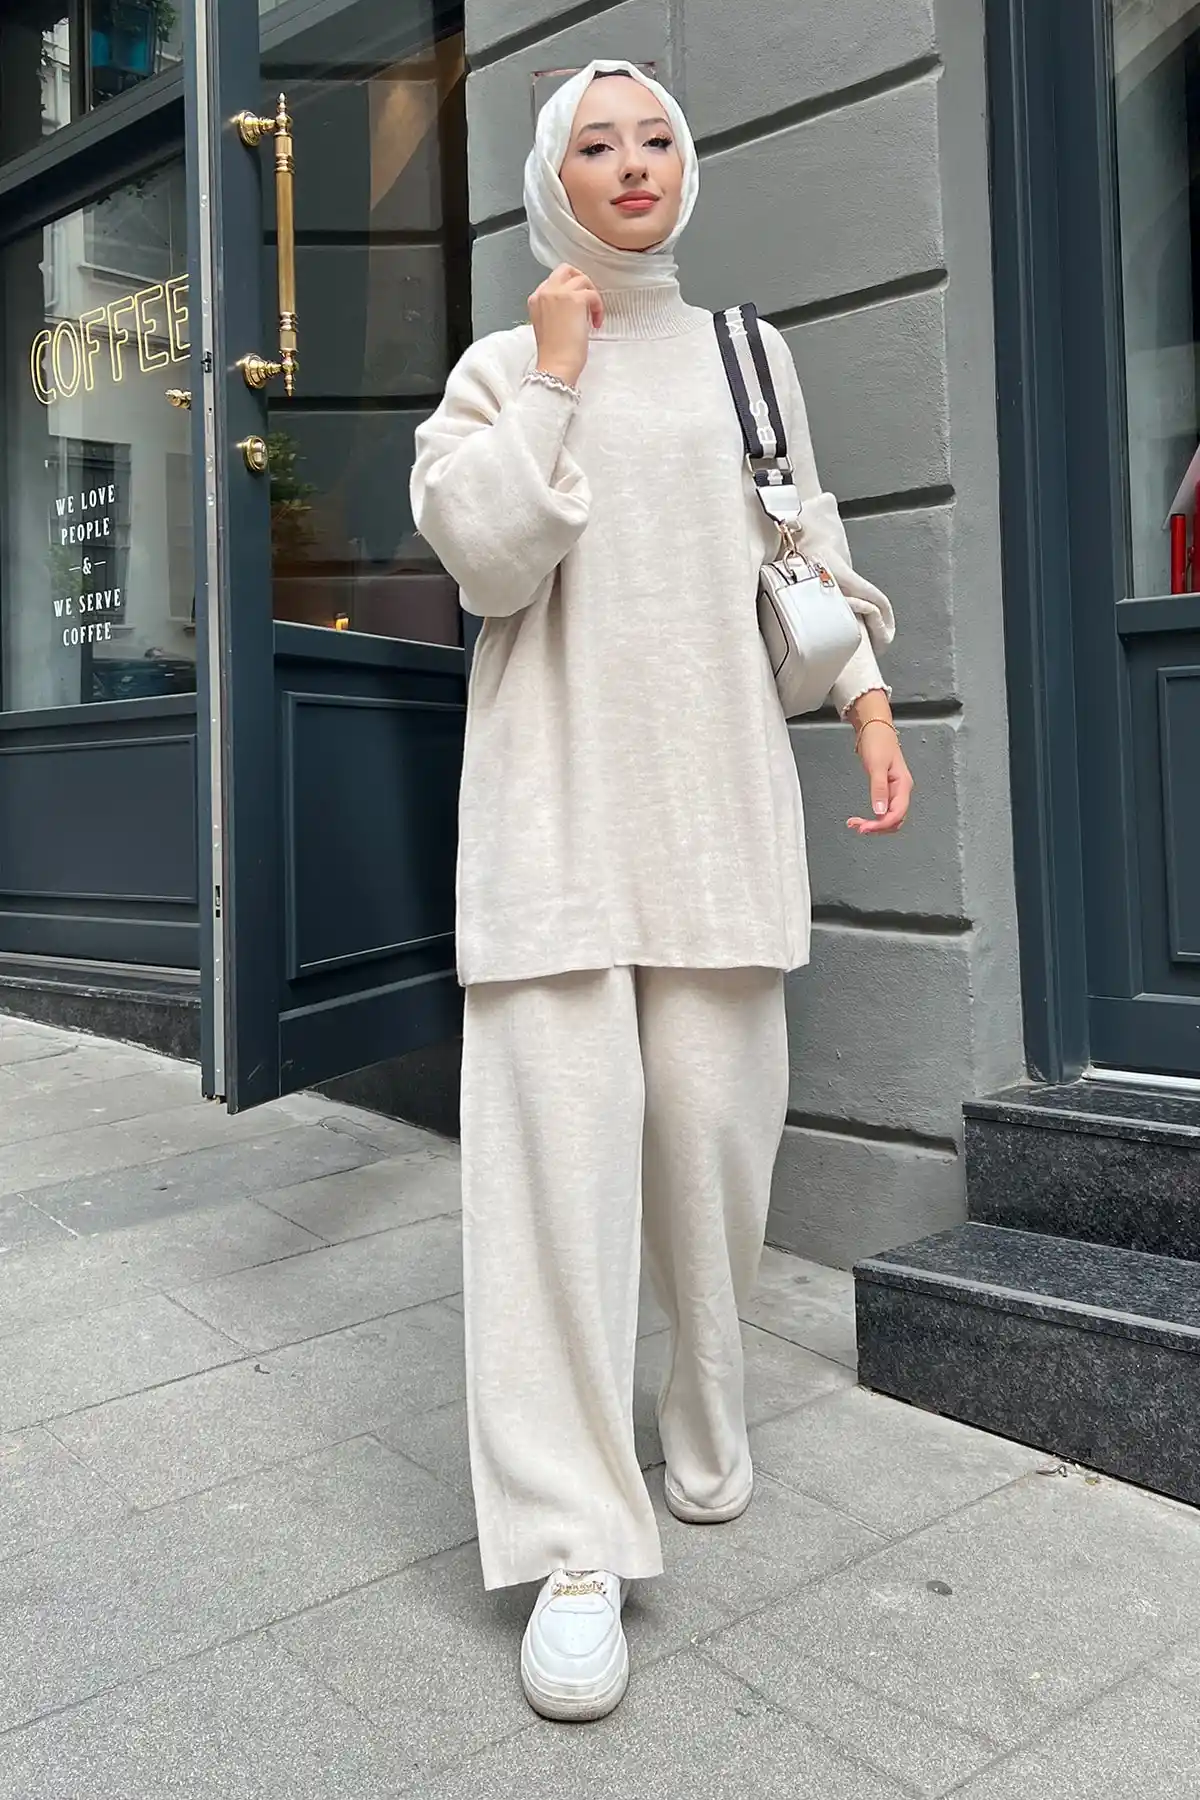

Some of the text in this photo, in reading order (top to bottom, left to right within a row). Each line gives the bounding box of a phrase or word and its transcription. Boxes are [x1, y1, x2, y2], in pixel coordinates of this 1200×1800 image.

[31, 273, 190, 405] COFFEE
[55, 484, 115, 516] WE LOVE
[61, 517, 110, 546] PEOPLE
[53, 588, 121, 618] WE SERVE
[63, 622, 111, 646] COFFEE
